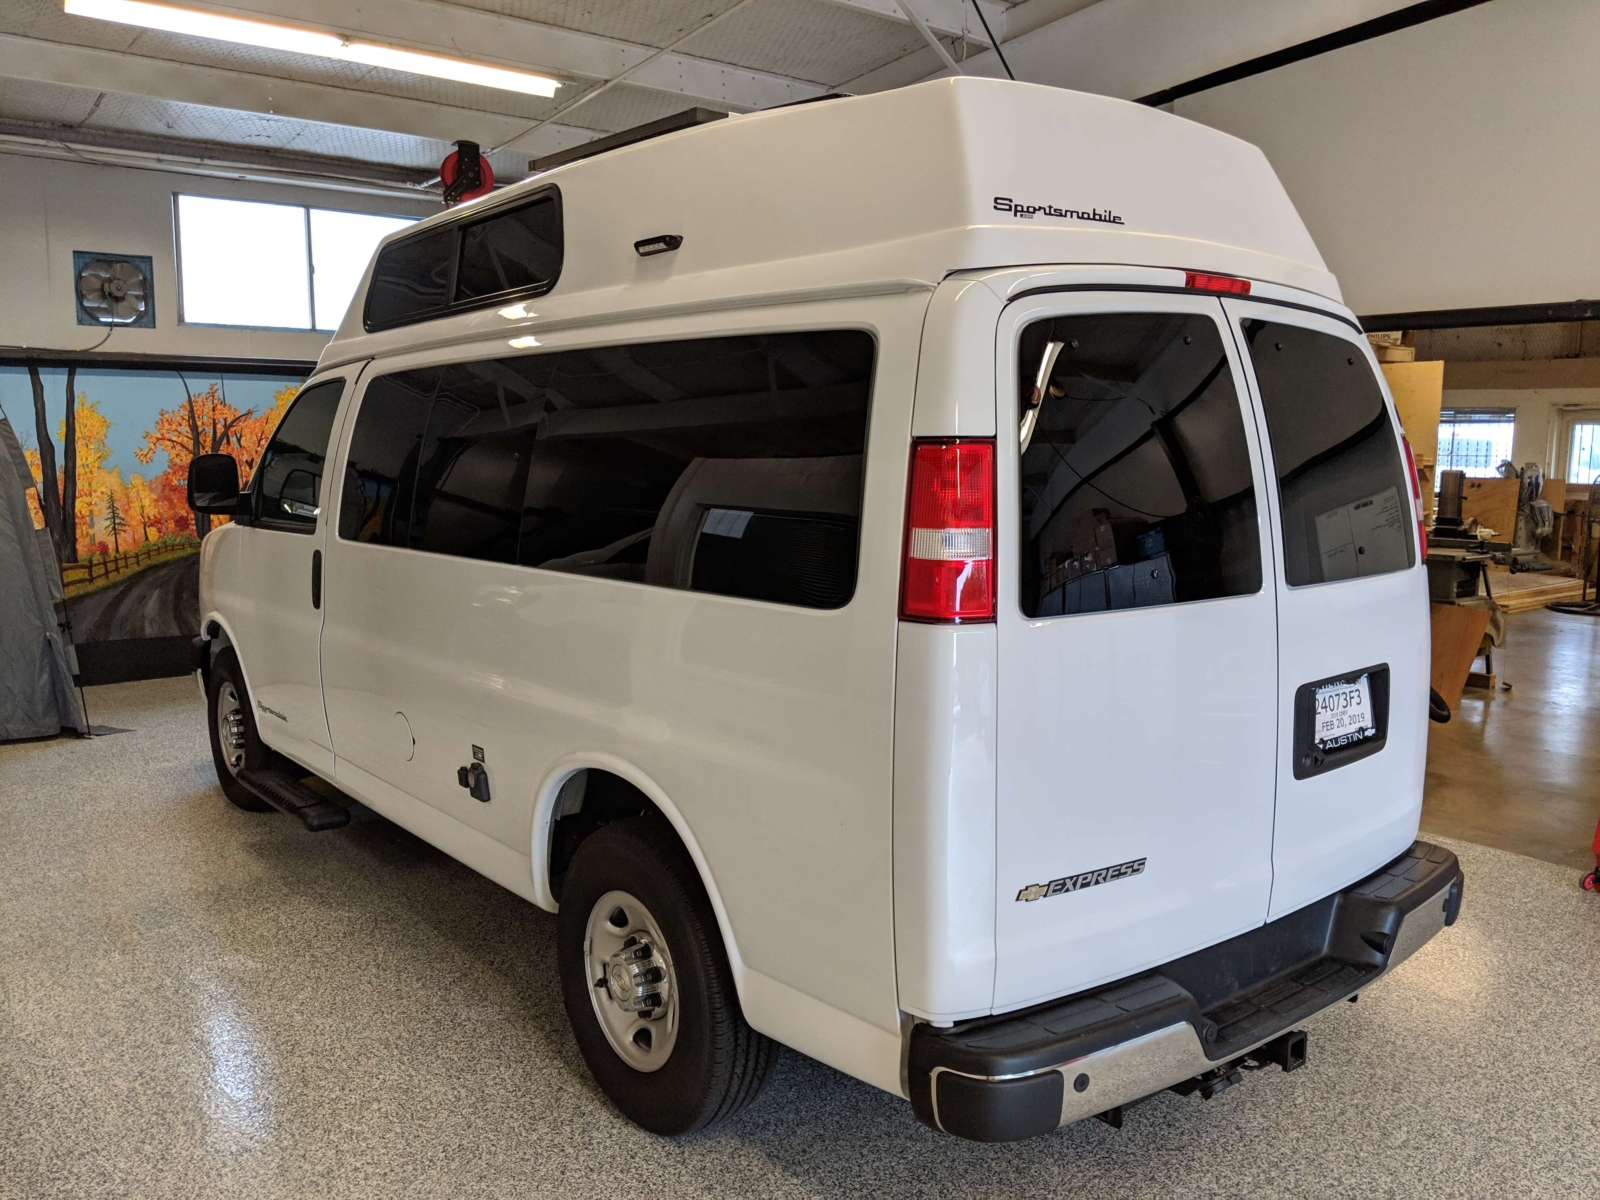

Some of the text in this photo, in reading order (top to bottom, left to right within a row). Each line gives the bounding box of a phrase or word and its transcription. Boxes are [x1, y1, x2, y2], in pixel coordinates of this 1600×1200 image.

[993, 196, 1125, 225] Sportsmobile
[1316, 689, 1362, 715] 24073F3
[1322, 720, 1335, 732] FEB
[1336, 717, 1347, 729] 20,
[1348, 712, 1365, 726] 2019
[1325, 732, 1363, 750] AUSTIN
[1046, 859, 1147, 897] EXPRESS
